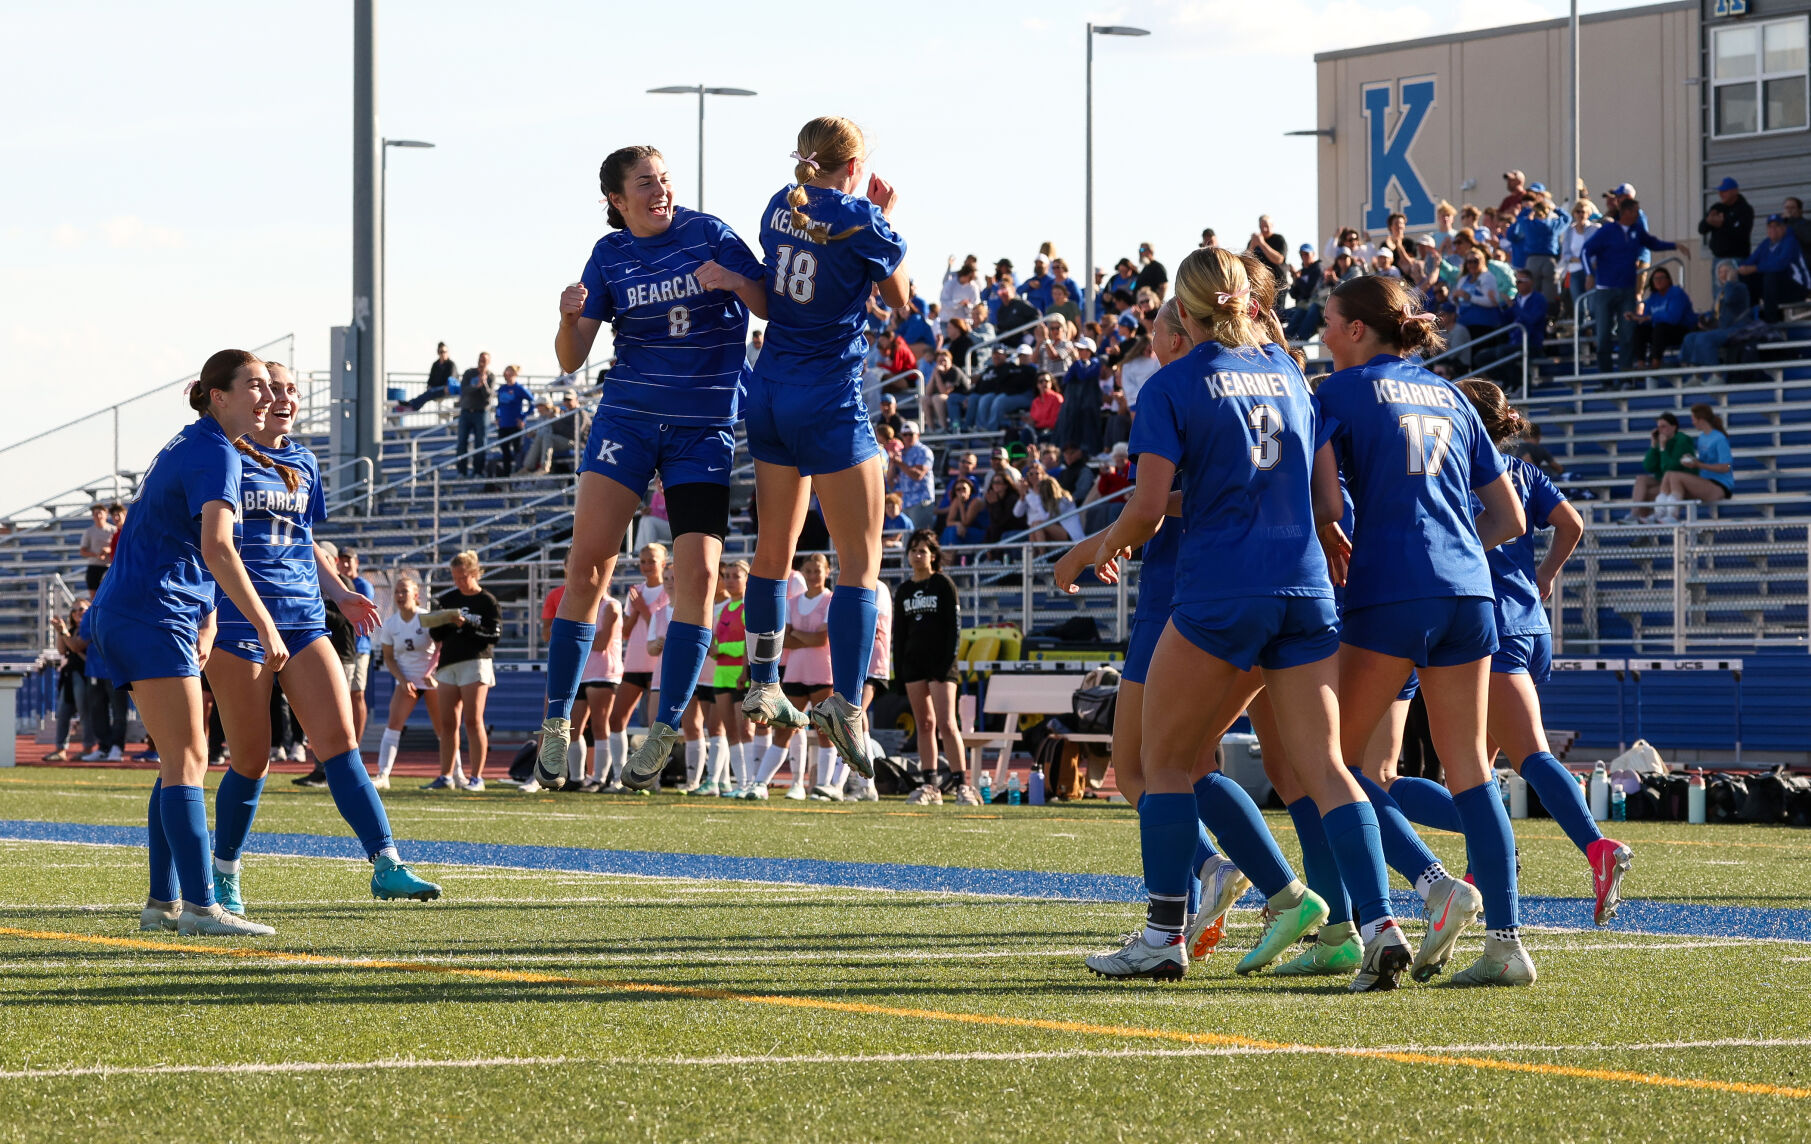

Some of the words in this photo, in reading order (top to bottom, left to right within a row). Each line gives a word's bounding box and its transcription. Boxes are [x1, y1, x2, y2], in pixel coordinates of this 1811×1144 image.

[1361, 73, 1438, 236] K
[626, 273, 704, 308] BEARCA
[774, 244, 818, 304] 18
[668, 304, 691, 338] 8
[1204, 371, 1293, 399] KEARNEY
[1372, 378, 1458, 408] KEARNEY
[596, 439, 623, 465] K
[1248, 404, 1282, 471] 3
[1399, 413, 1453, 476] 17
[404, 638, 415, 651] 3
[1674, 661, 1704, 670] UCS
